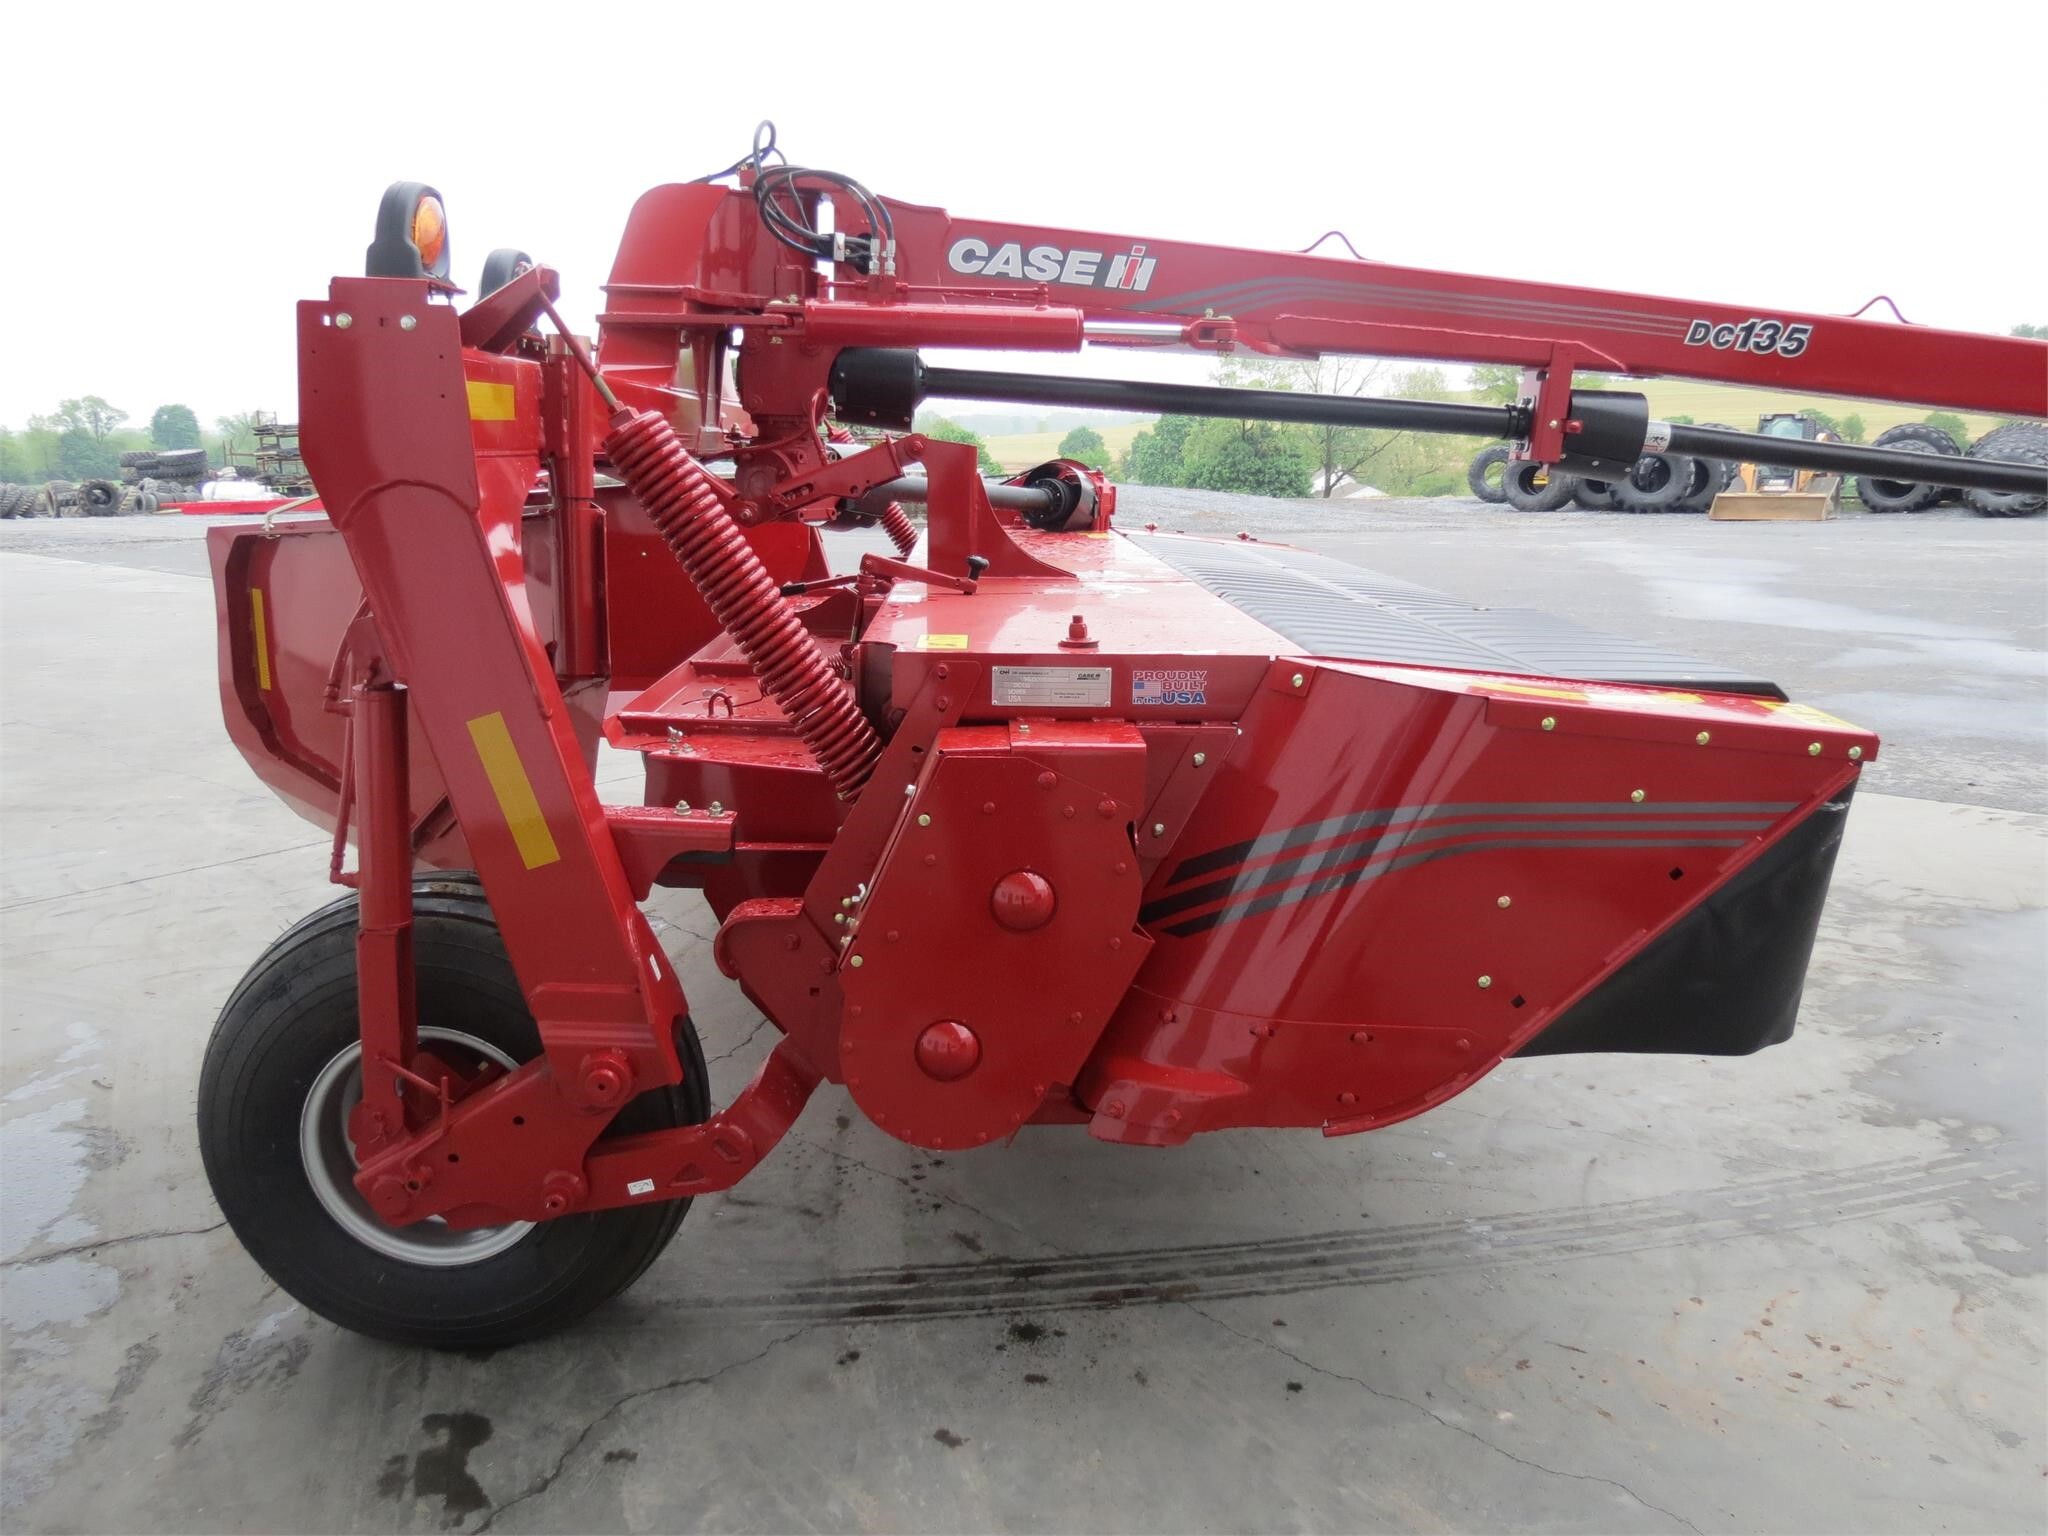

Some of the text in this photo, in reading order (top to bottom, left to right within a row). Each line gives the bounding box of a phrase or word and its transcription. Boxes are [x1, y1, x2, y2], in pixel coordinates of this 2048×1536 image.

[949, 238, 1103, 286] CASE
[1684, 318, 1813, 358] DC135
[1133, 671, 1207, 681] PROUDLY
[1162, 681, 1207, 692] BUILT
[1162, 692, 1206, 705] USA
